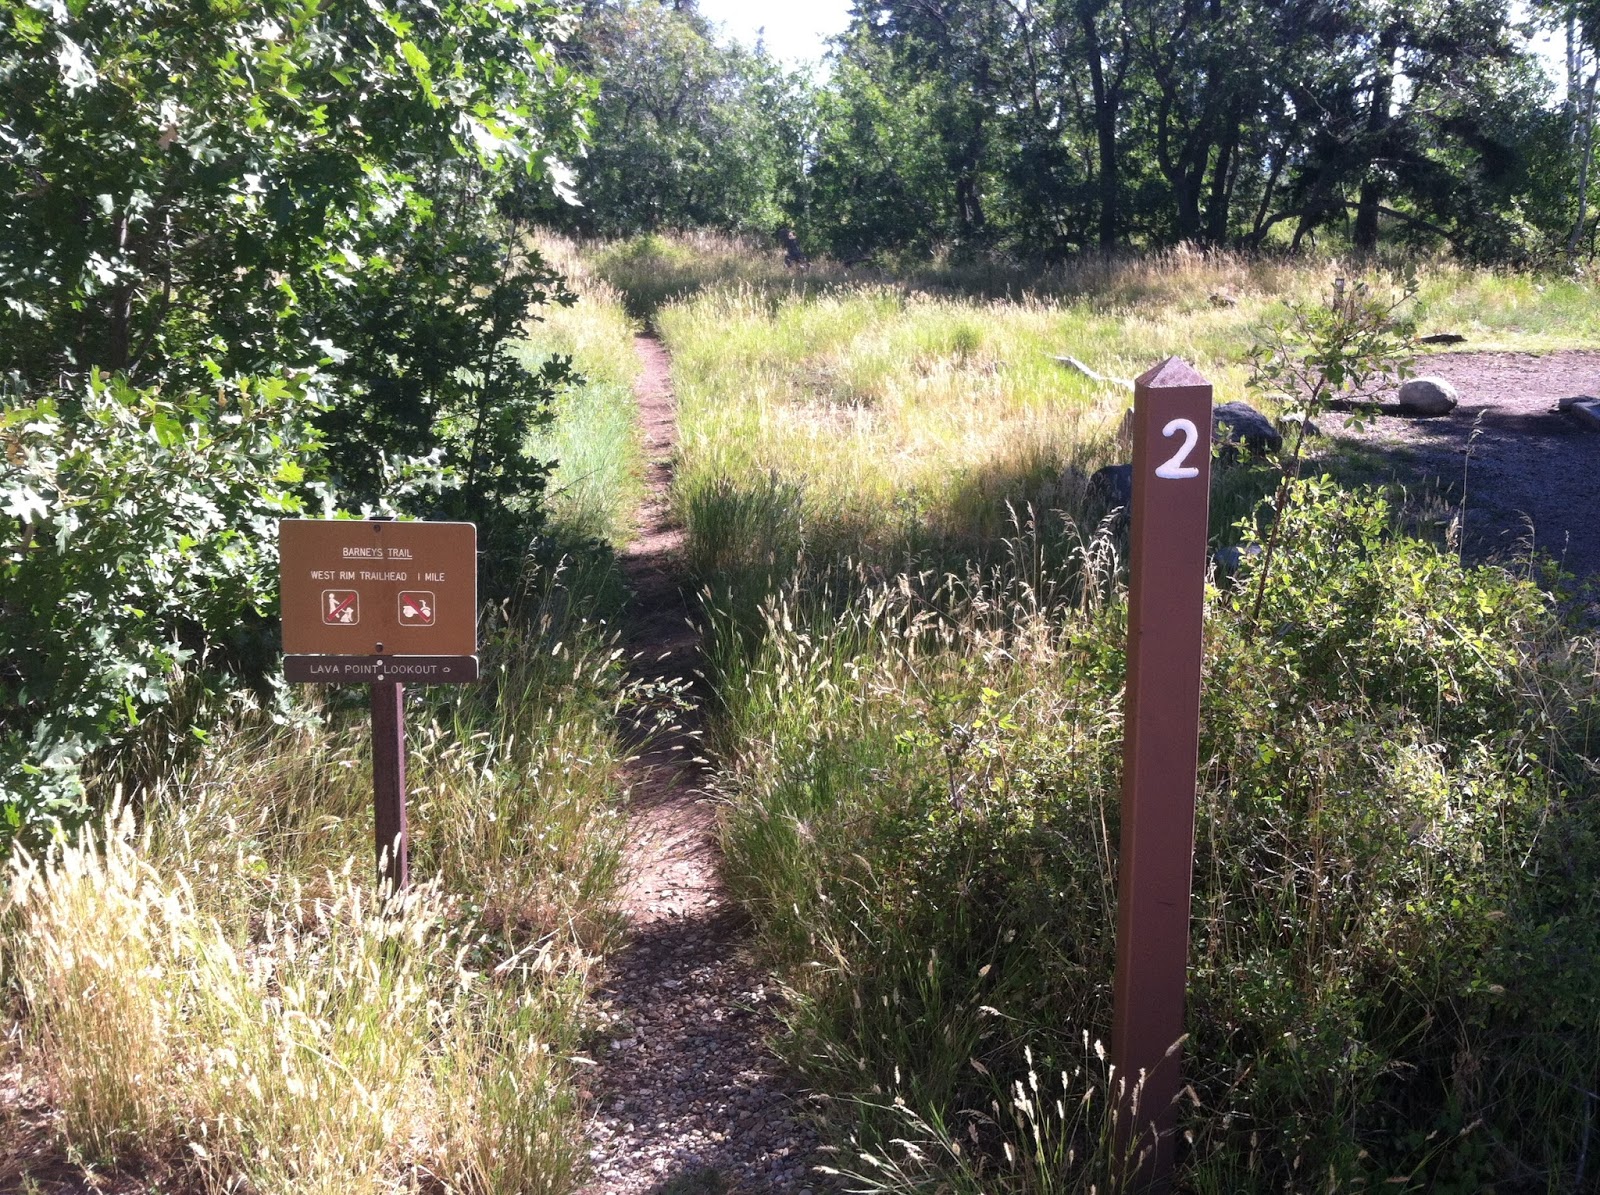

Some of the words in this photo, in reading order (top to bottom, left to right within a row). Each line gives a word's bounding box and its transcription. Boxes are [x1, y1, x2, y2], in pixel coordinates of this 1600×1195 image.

[1155, 418, 1199, 479] 2
[342, 547, 383, 557] BARNEYS
[387, 548, 413, 558] TRAIL
[310, 571, 335, 580] WEST
[339, 571, 355, 580] RIM
[360, 571, 407, 581] TRAILHEAD
[425, 572, 446, 582] MILE
[310, 664, 340, 674] LAVA
[345, 664, 379, 674] POINT
[383, 664, 437, 674] LOOKOUT
